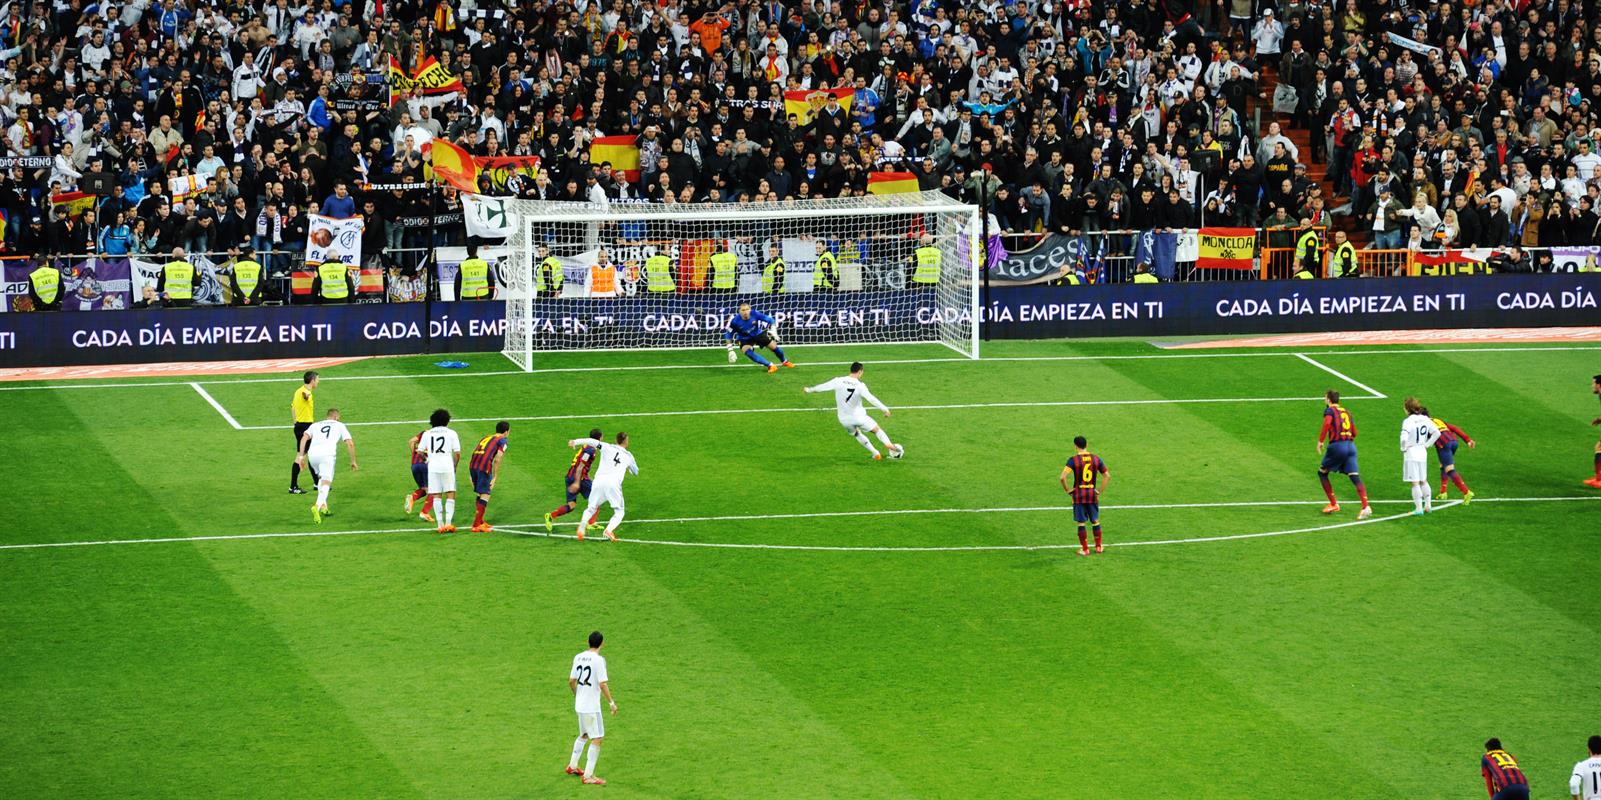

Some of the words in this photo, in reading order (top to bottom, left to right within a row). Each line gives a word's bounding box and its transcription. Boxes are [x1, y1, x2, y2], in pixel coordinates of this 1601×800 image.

[1202, 235, 1253, 249] MONCLOA
[604, 244, 680, 263] BURGS
[1216, 298, 1273, 317] CADA
[1279, 292, 1314, 316] DÍA
[1320, 295, 1408, 315] EMPIEZA
[1413, 294, 1440, 312] EN
[1445, 293, 1466, 311] TI
[1496, 291, 1556, 310] CADA
[1561, 285, 1598, 309] DÍA
[643, 313, 699, 332] CADA
[838, 309, 864, 327] EN
[870, 308, 889, 326] TI
[917, 306, 972, 325] CADA
[1020, 302, 1107, 322] EMPIEZA
[1111, 301, 1138, 320] EN
[1143, 300, 1164, 319] TI
[72, 329, 133, 348] CADA
[139, 322, 176, 346] DÍA
[182, 325, 273, 346] EMPIEZA
[279, 324, 306, 343] EN
[312, 323, 332, 342] TI
[363, 321, 422, 341] CADA
[429, 315, 463, 338] DÍA
[847, 388, 856, 403] 7
[1340, 412, 1351, 430] 3
[320, 425, 331, 439] 9
[1416, 425, 1428, 443] 19
[430, 436, 446, 454] 12
[479, 434, 494, 451] 4
[613, 451, 622, 467] 4
[1082, 463, 1093, 482] 6
[576, 664, 592, 687] 22
